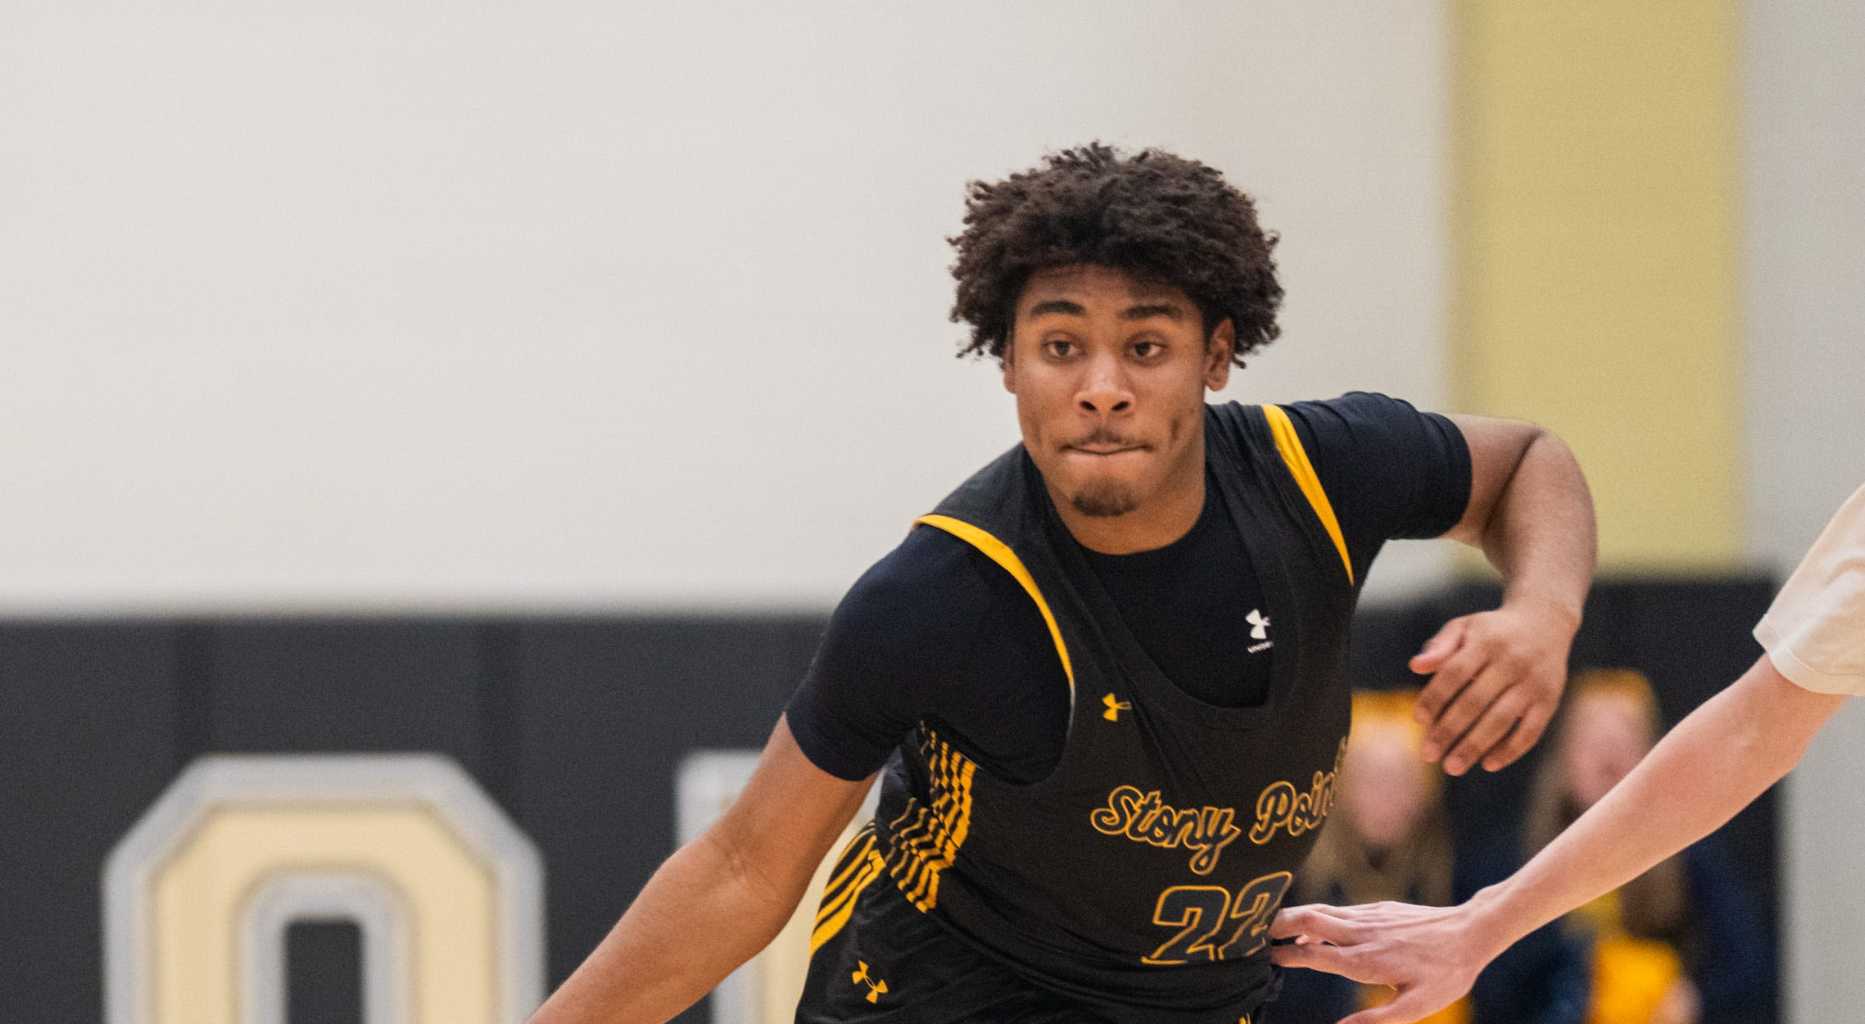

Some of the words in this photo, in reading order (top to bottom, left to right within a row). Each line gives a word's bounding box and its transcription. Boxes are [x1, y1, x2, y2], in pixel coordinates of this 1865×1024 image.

[1090, 785, 1242, 875] Stony
[1250, 767, 1337, 845] Poin
[1141, 870, 1293, 965] 22
